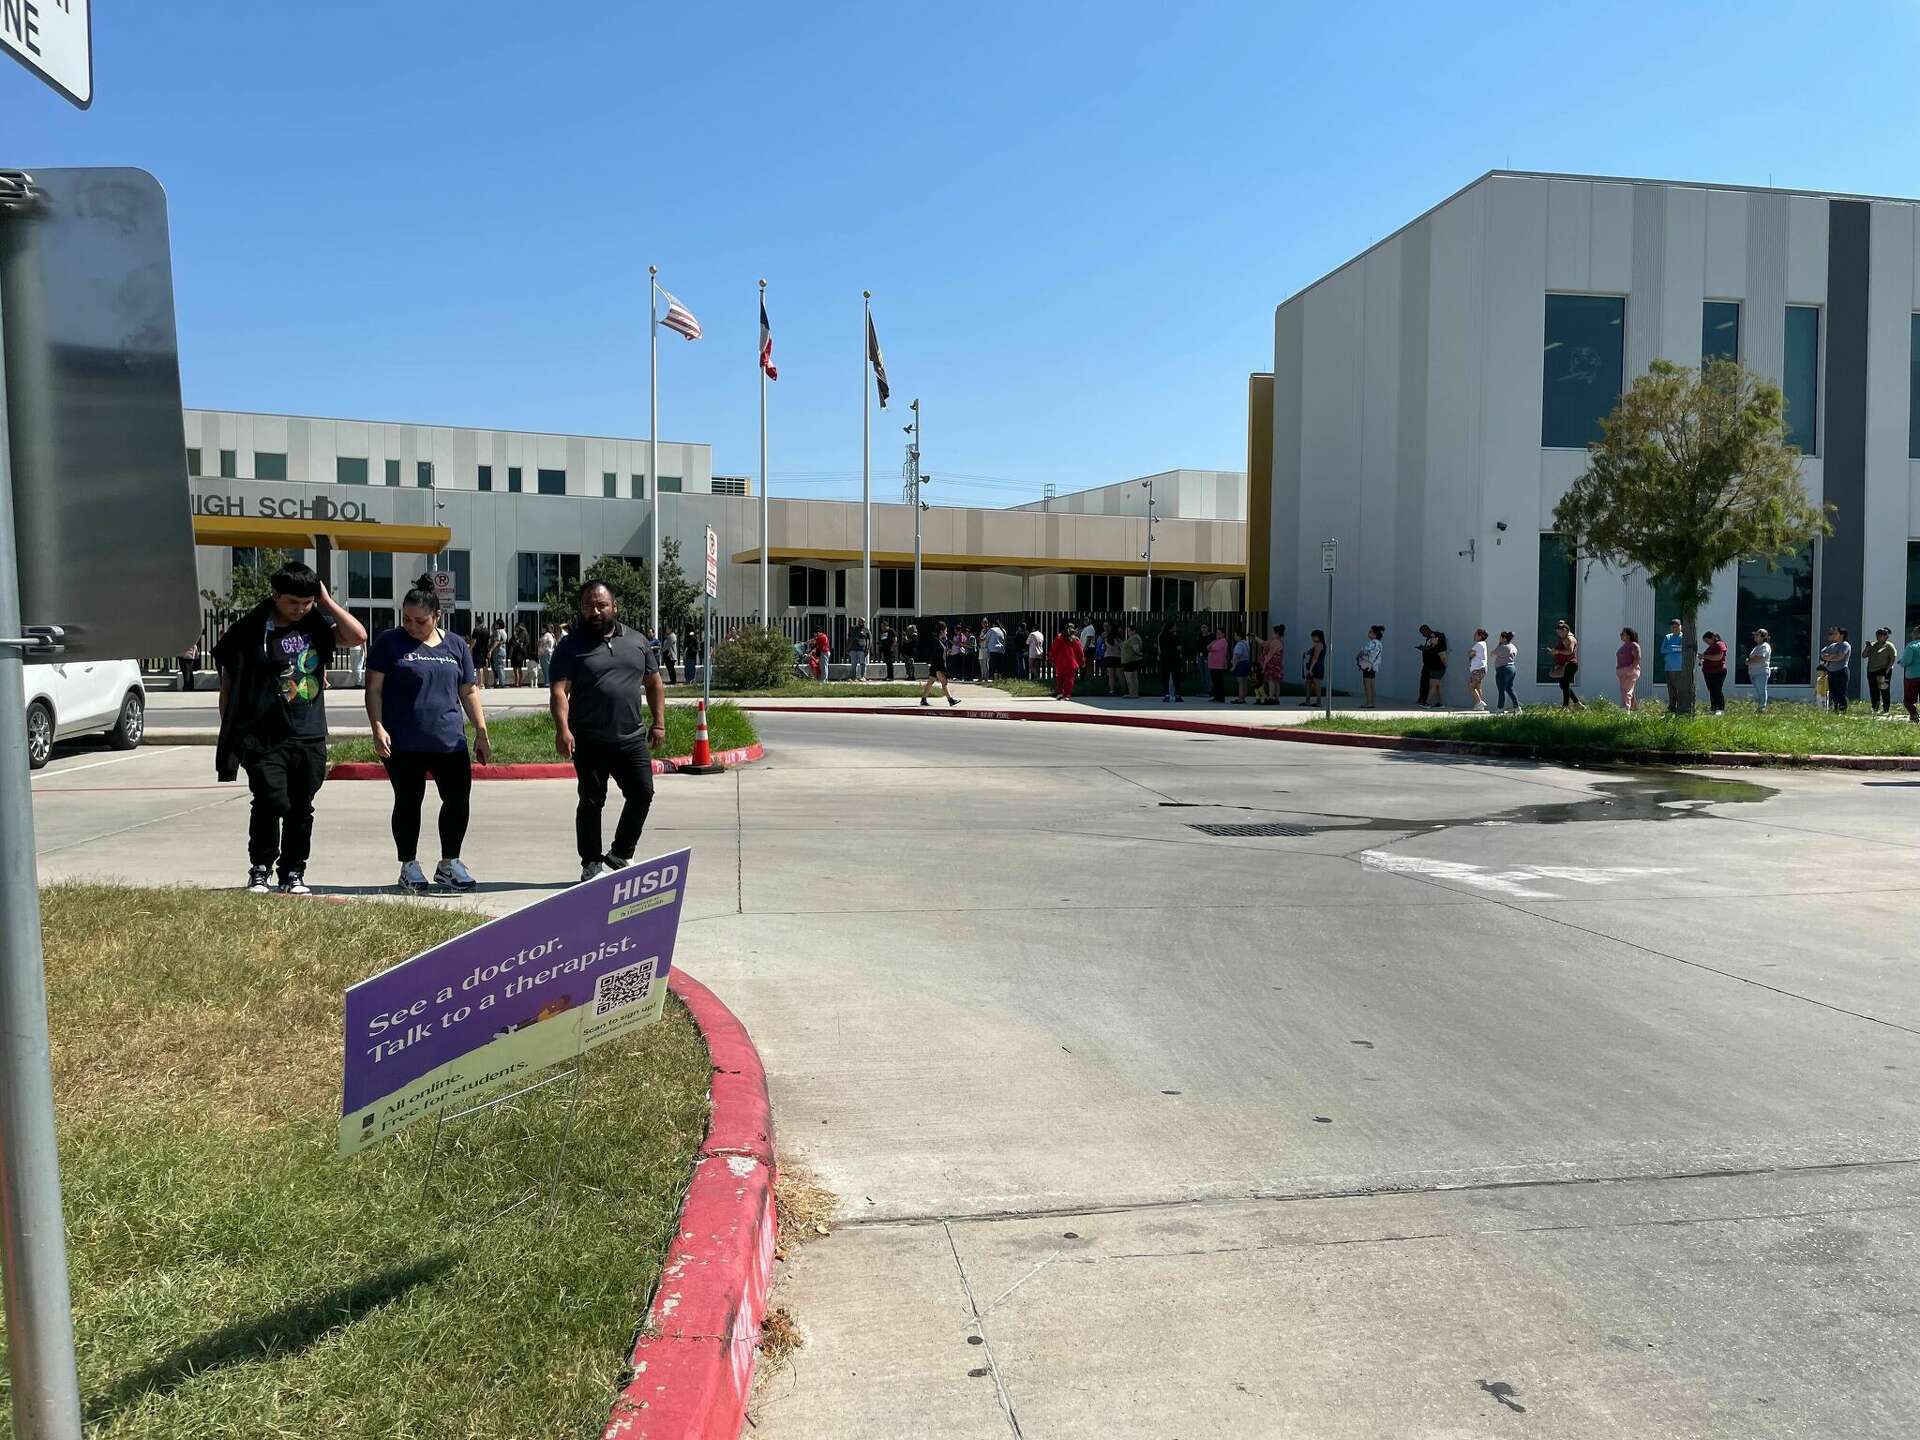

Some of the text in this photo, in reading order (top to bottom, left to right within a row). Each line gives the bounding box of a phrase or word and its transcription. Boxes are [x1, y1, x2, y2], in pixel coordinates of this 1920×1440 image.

[258, 496, 376, 522] SCHOOL
[612, 865, 679, 905] HISD
[367, 935, 637, 1064] Talk to a therapist.
[369, 936, 563, 1037] See a doctor.
[583, 1023, 606, 1036] Scan
[381, 1060, 529, 1132] Free for students.
[383, 1074, 465, 1119] All online.
